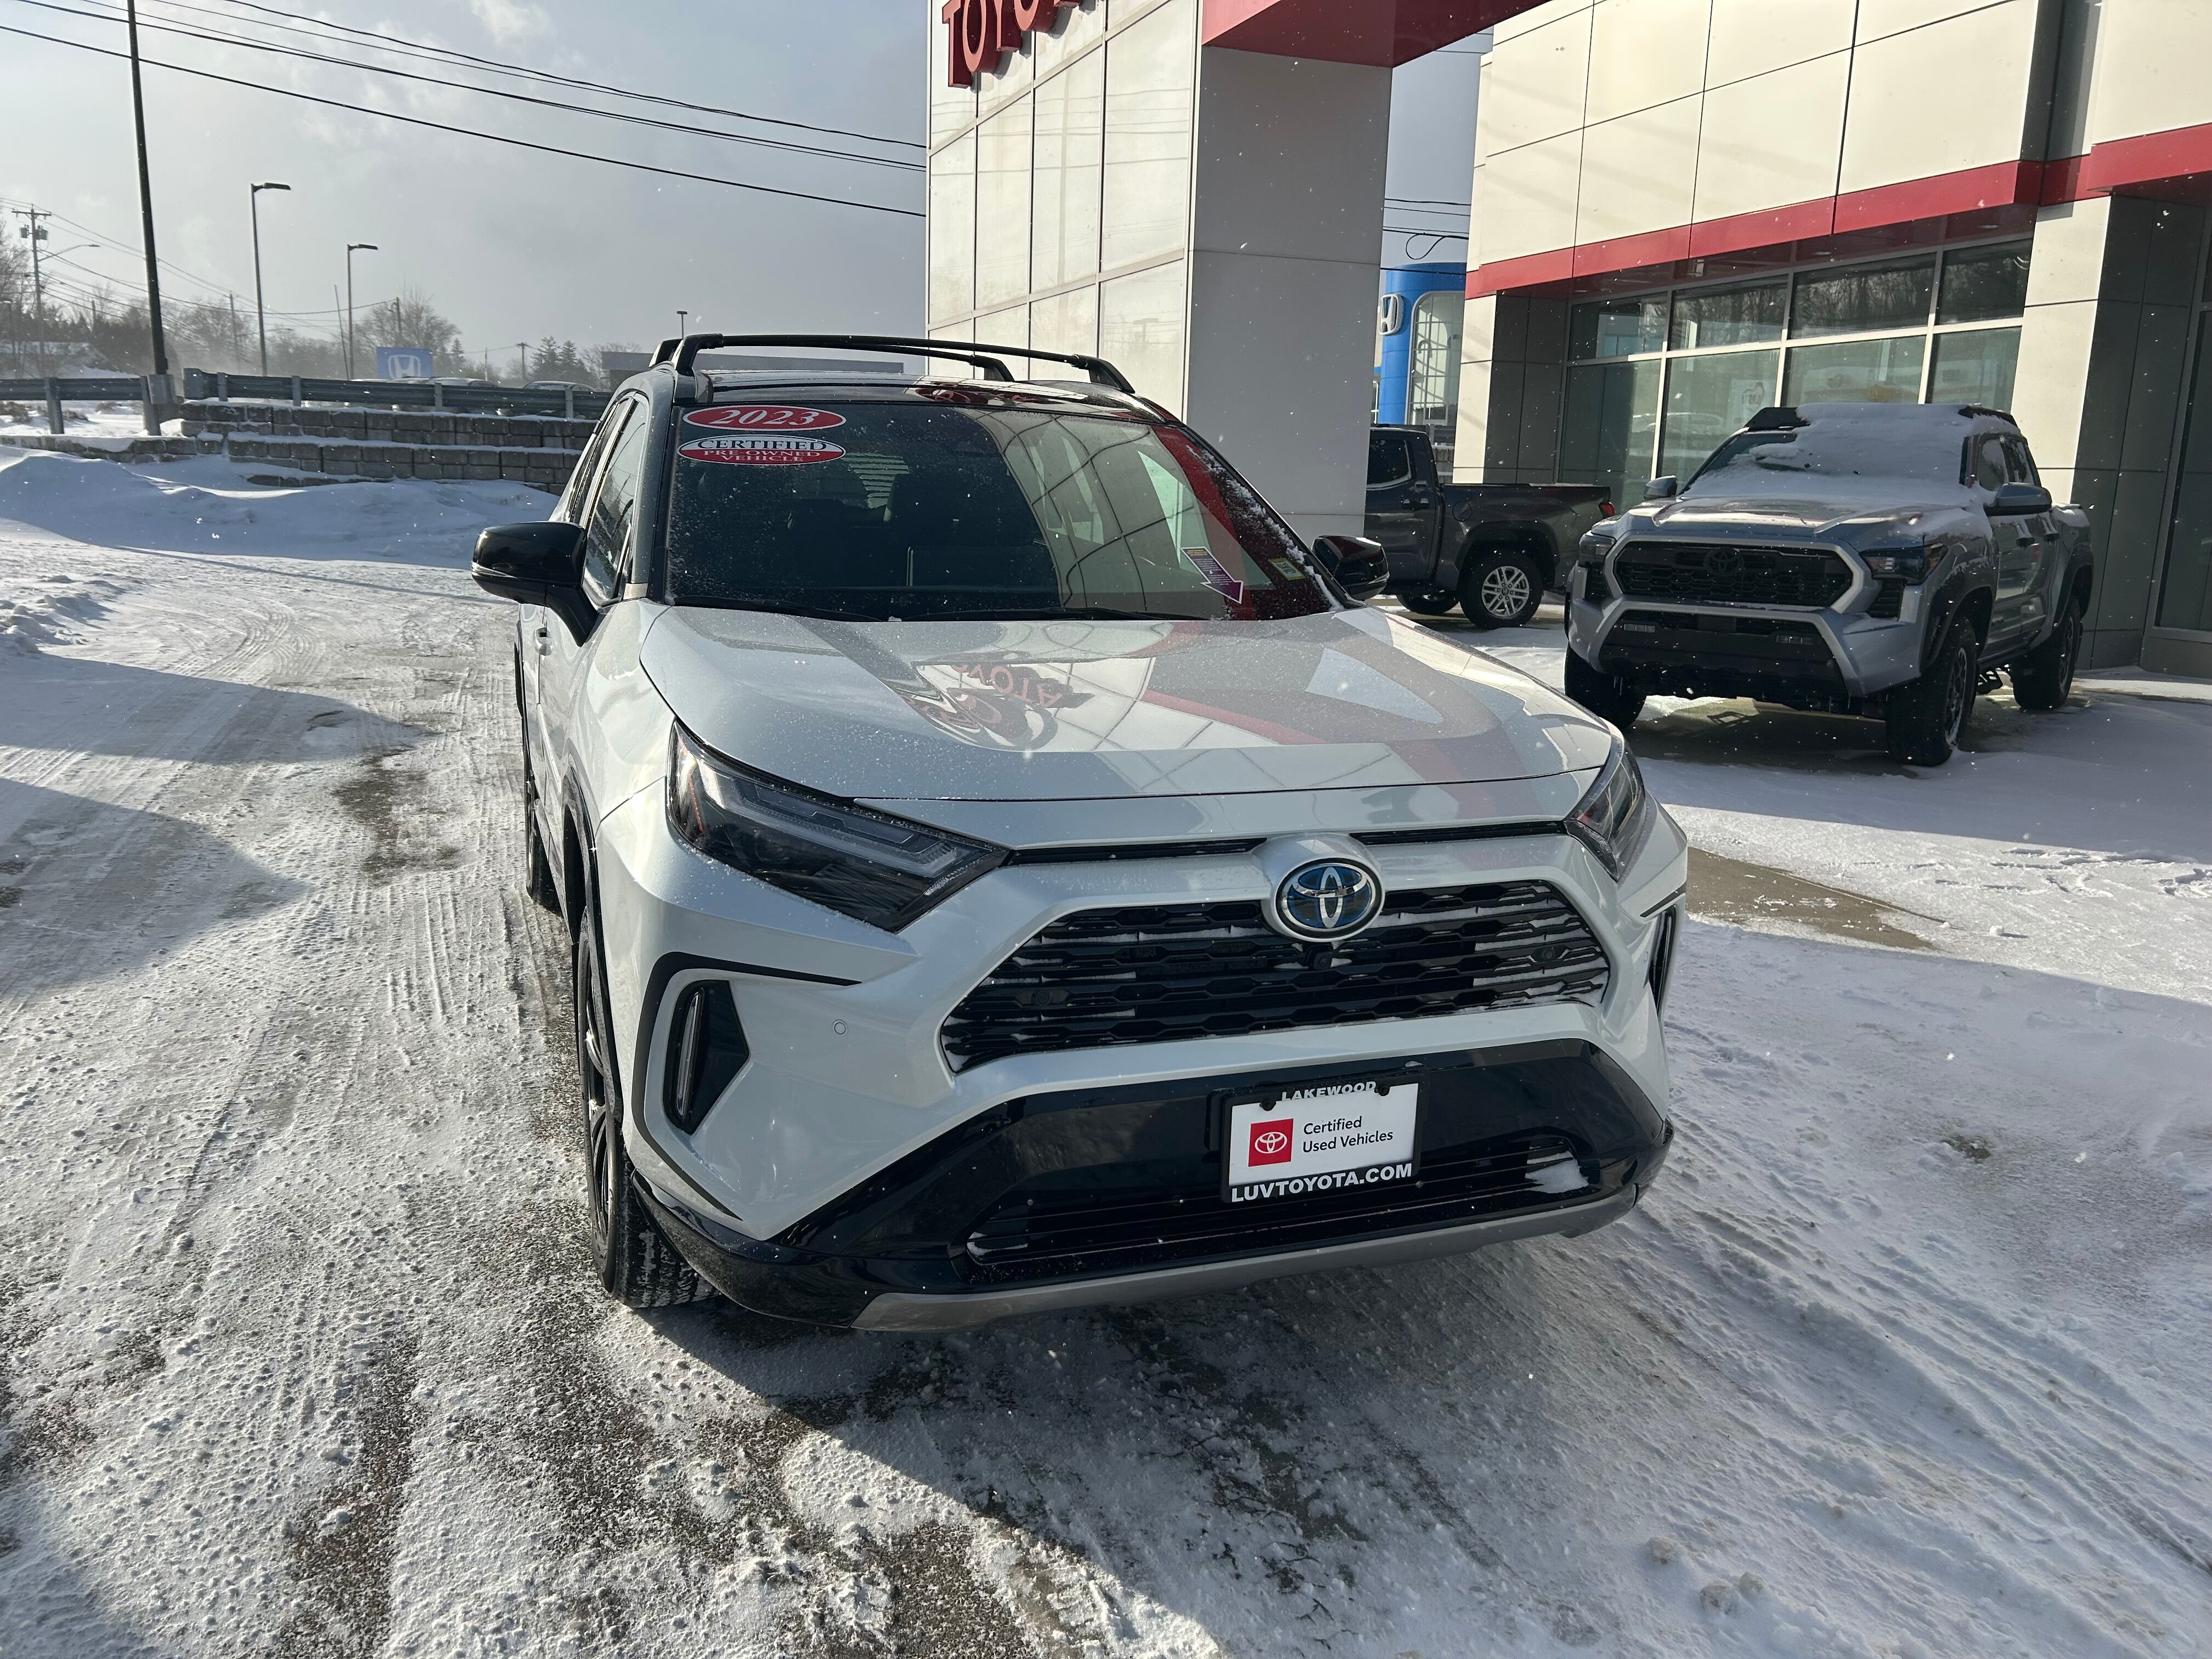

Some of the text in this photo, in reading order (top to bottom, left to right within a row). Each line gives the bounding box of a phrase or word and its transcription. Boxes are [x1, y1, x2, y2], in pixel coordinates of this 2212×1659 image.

[709, 410, 820, 425] 2023
[697, 440, 827, 450] CERTIFIED
[1282, 1081, 1376, 1102] LAKEWOOD
[1304, 1115, 1363, 1135] Certified
[1303, 1130, 1393, 1153] Used Vehicles
[1231, 1163, 1412, 1203] LUVTOYOTA.COM
